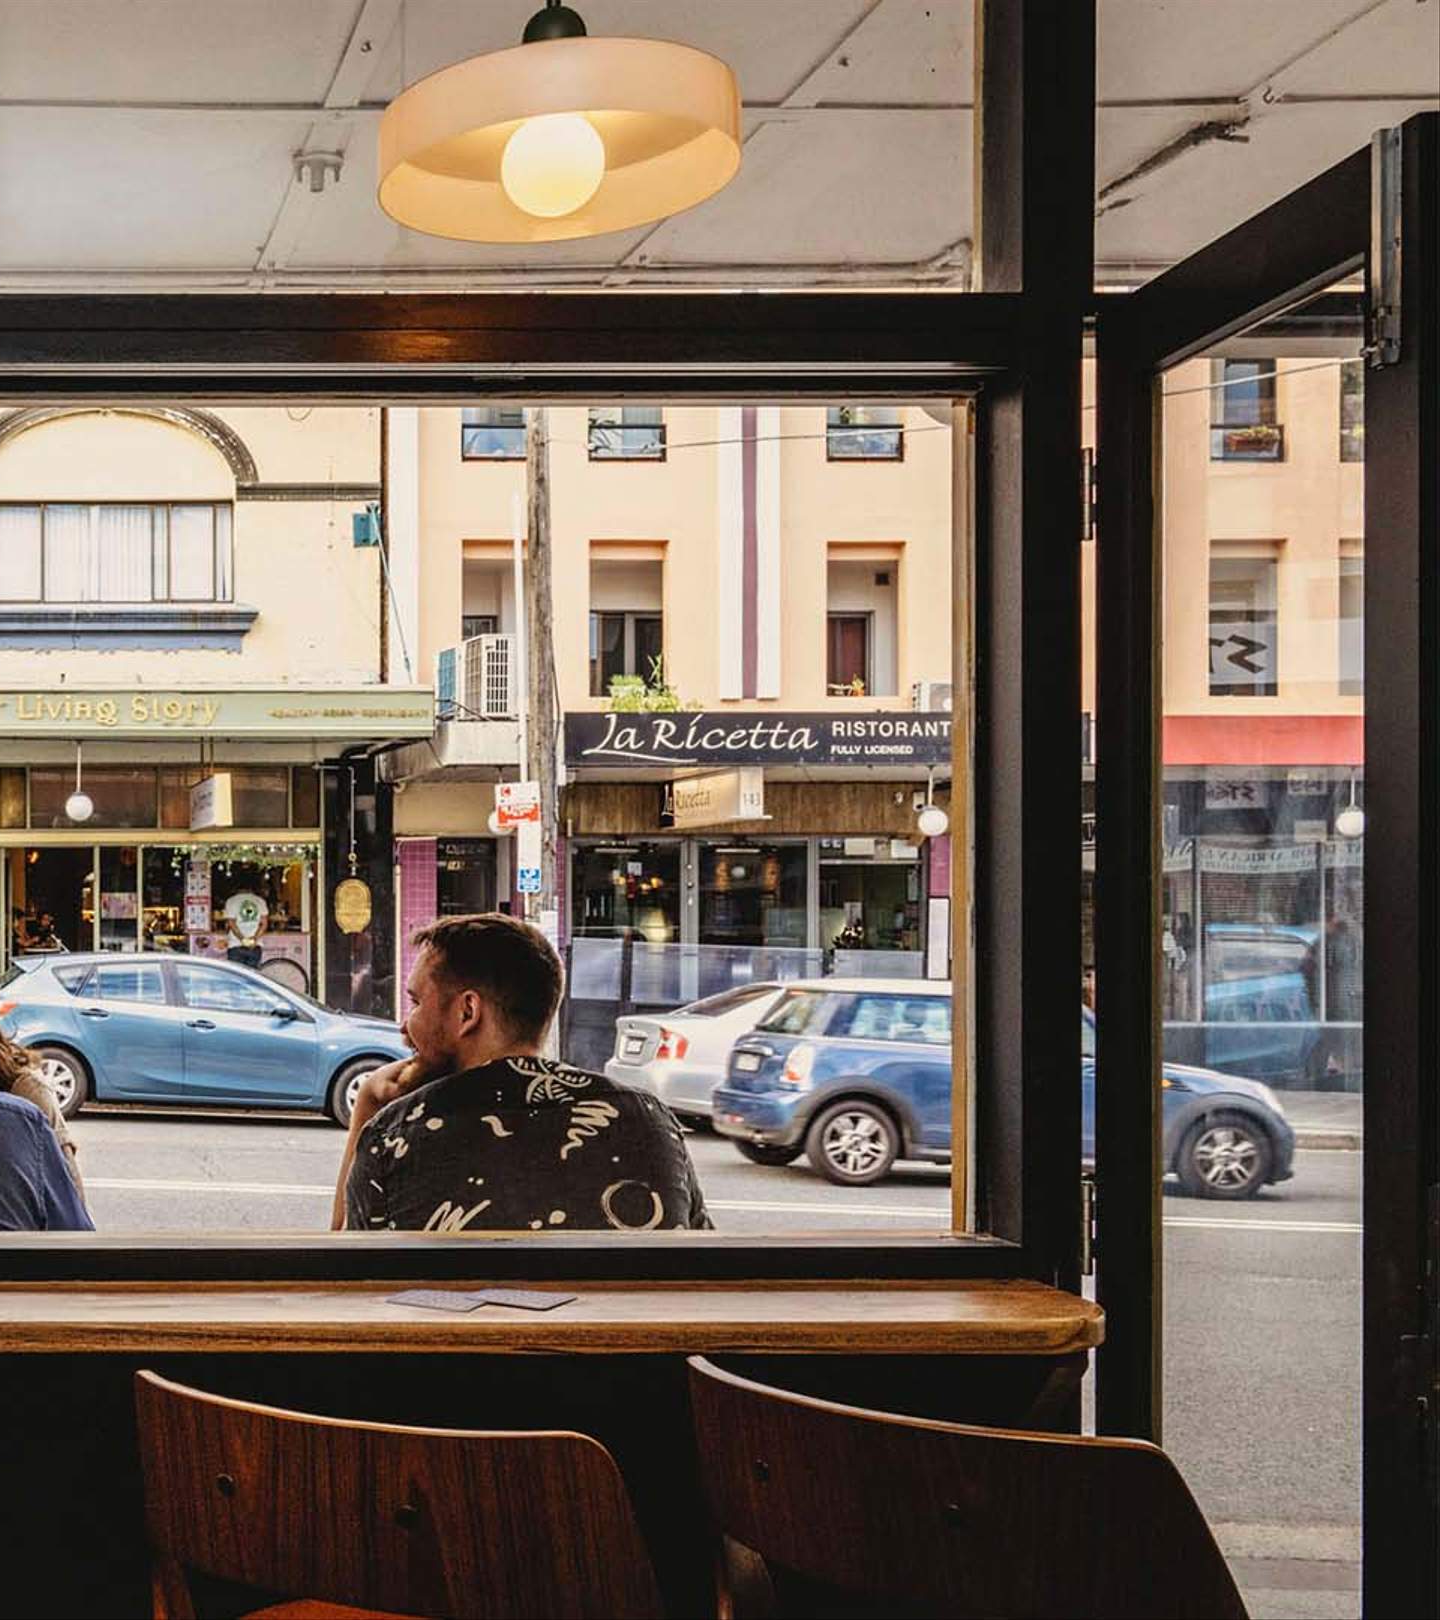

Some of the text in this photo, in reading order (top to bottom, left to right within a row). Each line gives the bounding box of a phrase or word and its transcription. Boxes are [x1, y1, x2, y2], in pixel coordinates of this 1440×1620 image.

[16, 693, 119, 726] Living
[131, 694, 223, 726] Story
[651, 713, 819, 751] Ricetta
[831, 721, 951, 737] RISTORANT
[831, 745, 861, 755] FULLY
[864, 745, 914, 755] LICENSED
